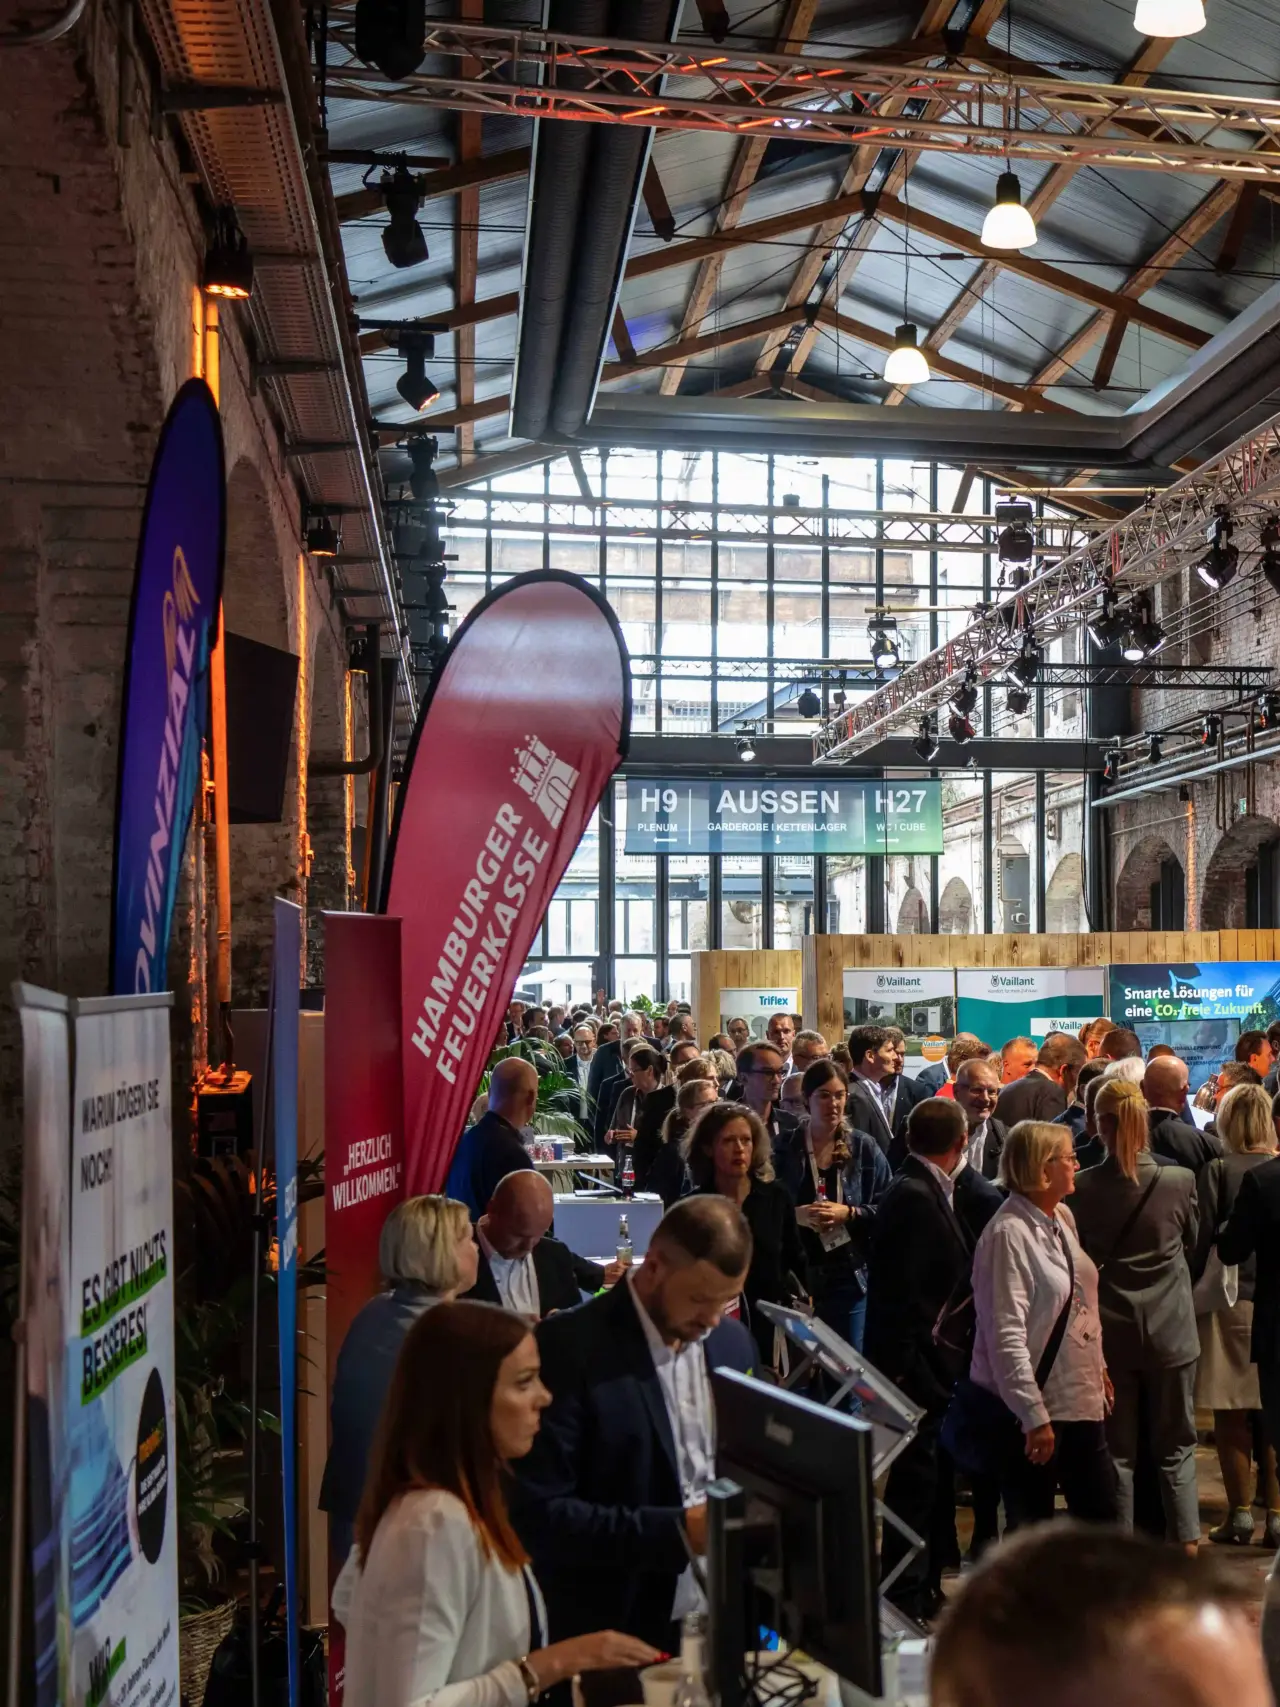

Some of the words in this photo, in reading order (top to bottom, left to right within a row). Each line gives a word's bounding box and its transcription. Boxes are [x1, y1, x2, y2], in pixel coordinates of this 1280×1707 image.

[641, 789, 677, 814] H9
[716, 790, 840, 814] AUSSEN
[875, 790, 926, 814] H27
[637, 823, 677, 832] PLENUM
[707, 823, 768, 832] GARDEROBE
[777, 823, 847, 832] KETTENLAGER
[876, 823, 892, 832] WC
[899, 823, 926, 832] CUBE
[410, 802, 523, 1057] HAMBURGER
[436, 835, 549, 1085] FEUERKASSE
[886, 977, 921, 986] Vaillant
[1000, 976, 1035, 986] Vaillant
[759, 995, 788, 1006] Triflex
[1124, 988, 1170, 1000] Smarte
[1173, 986, 1232, 1001] Lösungen
[1235, 985, 1254, 997] für
[1125, 1005, 1153, 1017] eine
[1214, 1002, 1267, 1015] Zukunft.
[1059, 1021, 1083, 1030] Vailla
[82, 1092, 115, 1134] WARUM
[116, 1081, 146, 1122] ZÖGERN
[148, 1079, 159, 1112] SIE
[82, 1274, 100, 1327] ES
[104, 1254, 127, 1312] GIBT
[130, 1230, 167, 1294] NICHTS
